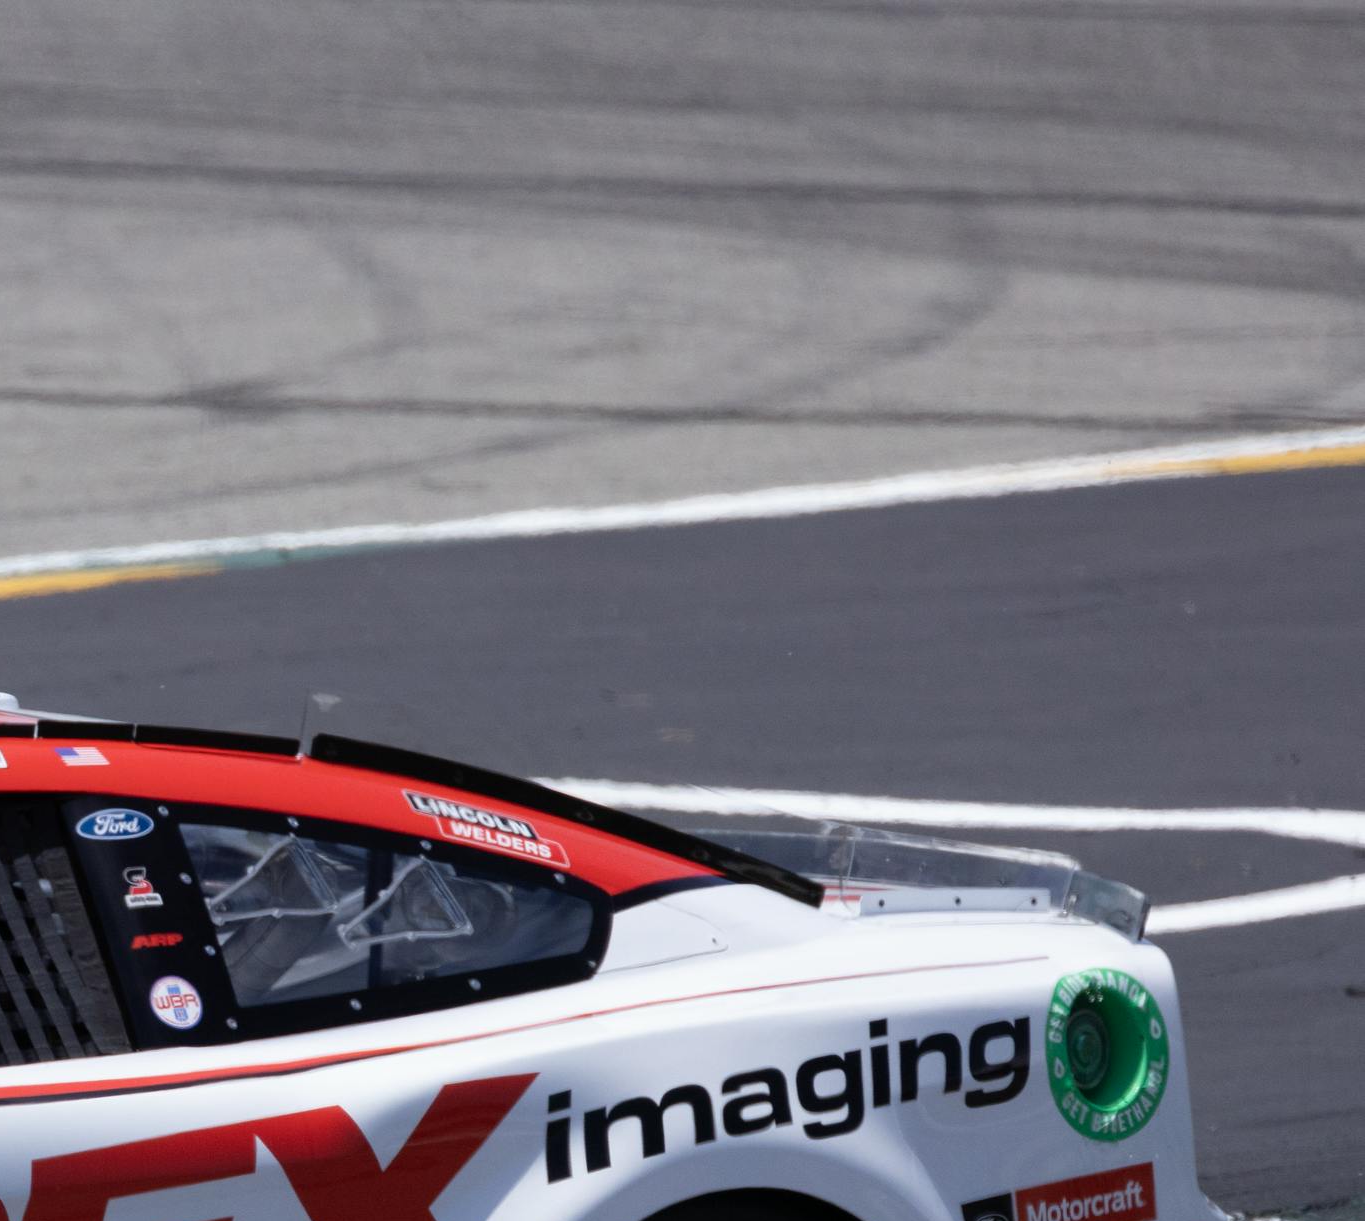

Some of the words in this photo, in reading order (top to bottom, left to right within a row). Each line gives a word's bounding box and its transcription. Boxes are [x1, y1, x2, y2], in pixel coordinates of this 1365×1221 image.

[90, 811, 144, 837] Ford
[413, 794, 533, 838] LINCOLN
[450, 821, 553, 859] WELDERS
[131, 932, 183, 950] ARP
[153, 993, 200, 1011] WBR
[545, 1017, 1031, 1185] imaging
[1061, 1091, 1089, 1125] GET
